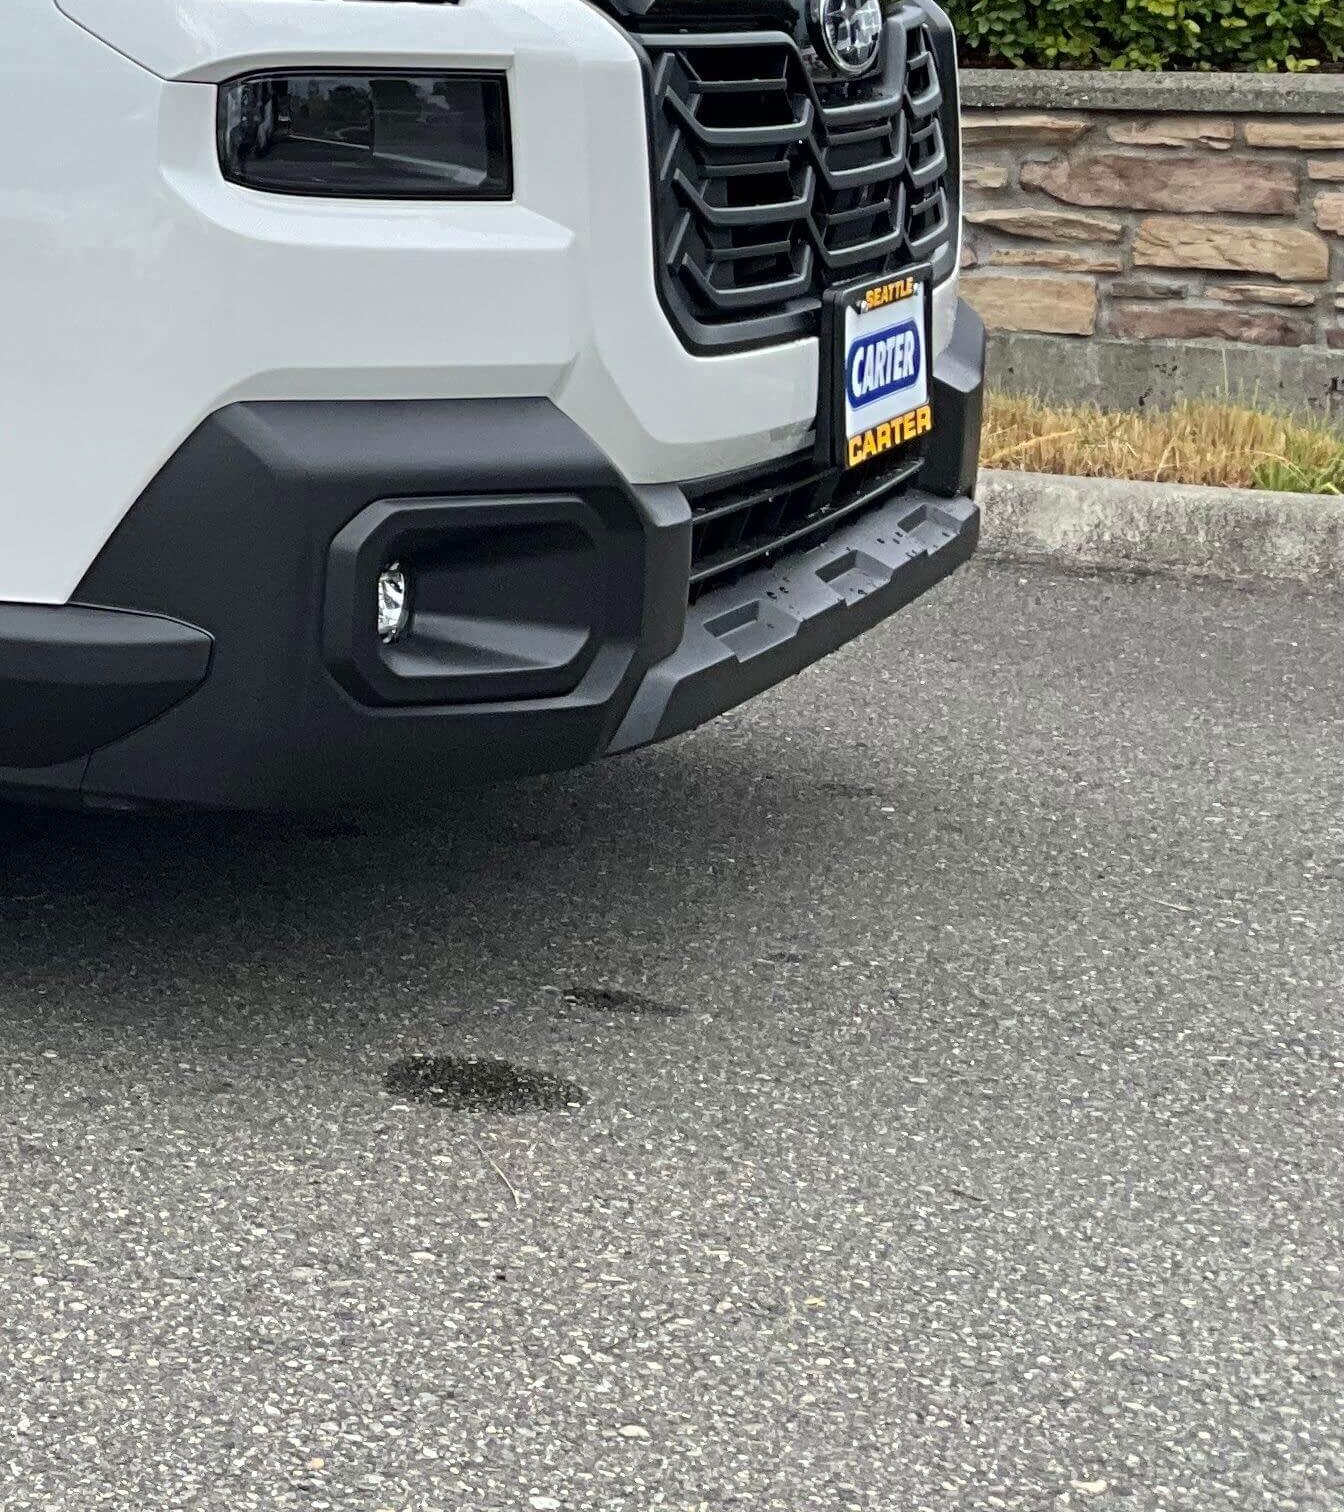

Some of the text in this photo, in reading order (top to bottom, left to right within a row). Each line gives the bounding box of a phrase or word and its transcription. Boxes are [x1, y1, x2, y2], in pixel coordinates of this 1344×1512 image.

[866, 278, 914, 308] SEATTLE
[852, 331, 914, 397] CARTER
[849, 406, 932, 466] CARTER
